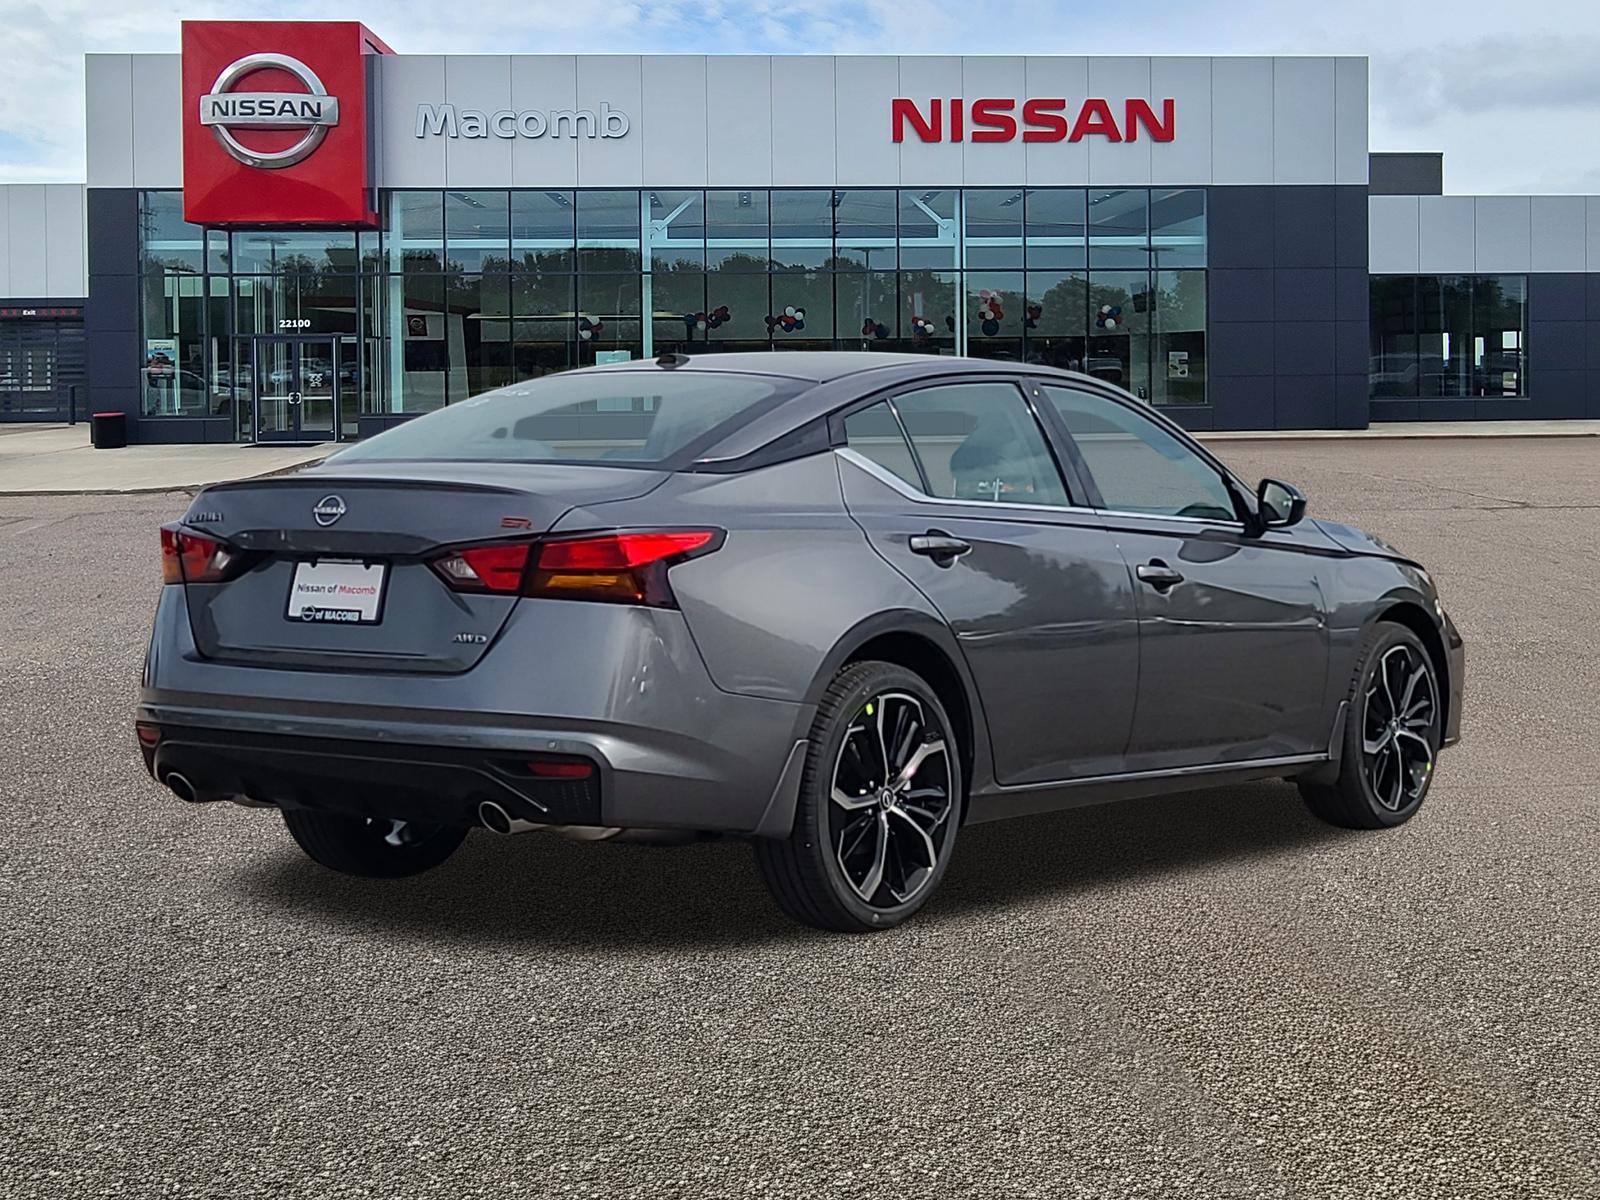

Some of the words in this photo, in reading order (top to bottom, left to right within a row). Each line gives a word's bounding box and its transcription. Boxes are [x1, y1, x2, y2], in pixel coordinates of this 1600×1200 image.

[211, 100, 322, 118] NISSAN
[415, 102, 631, 139] Macomb
[892, 98, 1176, 143] NISSAN
[279, 319, 311, 328] 22100
[298, 584, 325, 593] Nissan
[328, 585, 337, 593] of
[339, 586, 376, 595] Macomb
[325, 611, 359, 621] MACOMB
[452, 633, 488, 644] AWD
